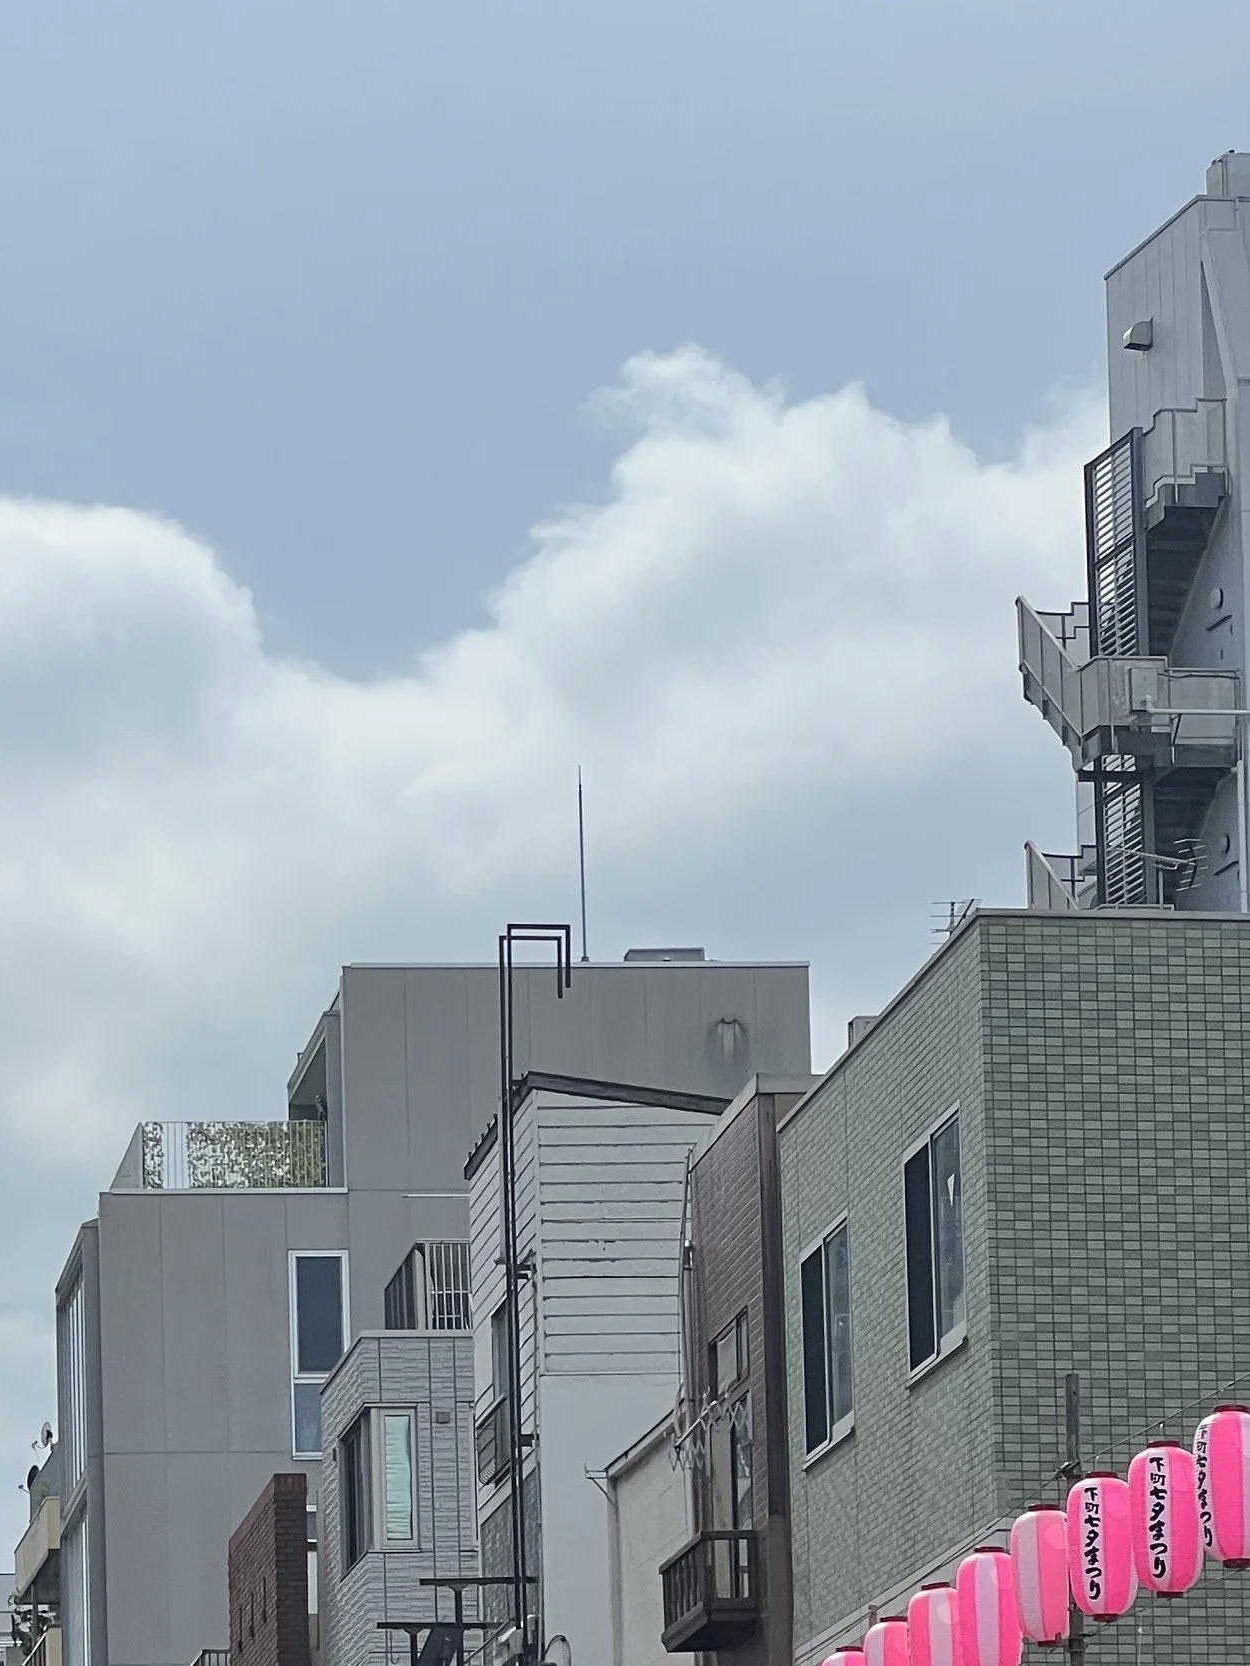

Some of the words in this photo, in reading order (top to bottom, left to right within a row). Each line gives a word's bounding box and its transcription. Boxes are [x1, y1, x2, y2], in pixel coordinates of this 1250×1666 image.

[1084, 1487, 1102, 1601] 下町七夕まつり
[1149, 1457, 1168, 1579] 下町七夕まつり
[1197, 1425, 1213, 1547] 下町七夕まつり
